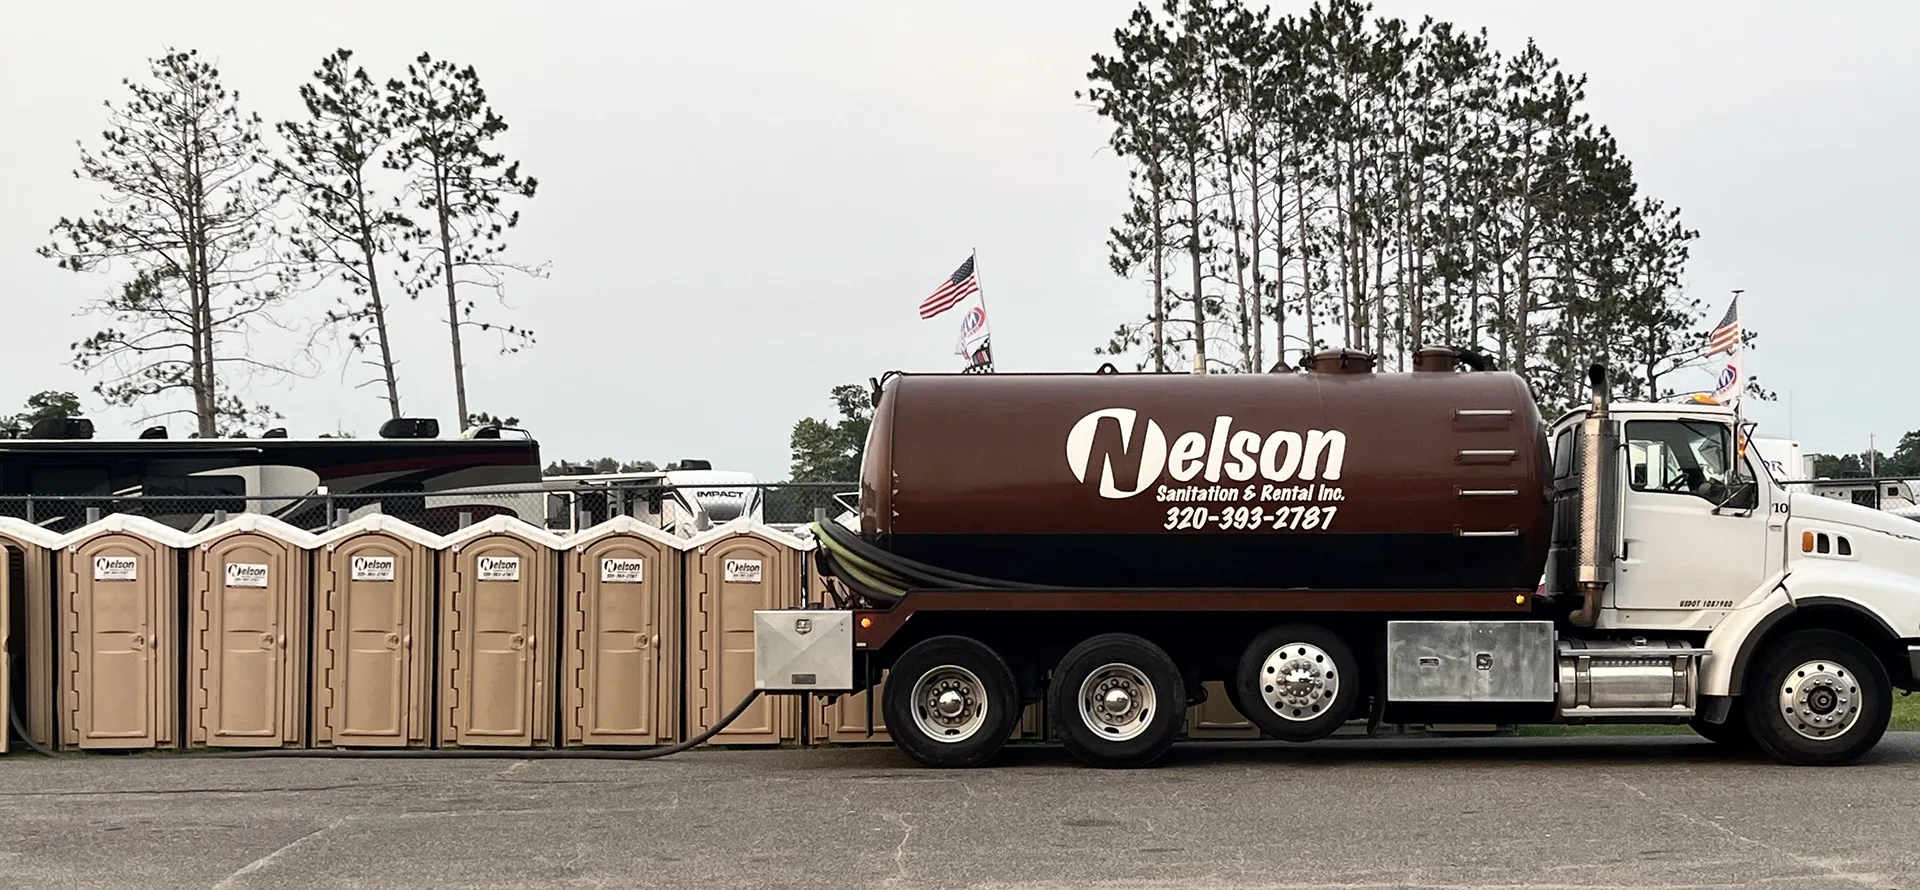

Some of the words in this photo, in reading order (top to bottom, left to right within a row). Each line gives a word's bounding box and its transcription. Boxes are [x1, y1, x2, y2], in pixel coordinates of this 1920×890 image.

[1066, 407, 1346, 499] Nelson
[1157, 484, 1239, 501] Sanitation
[1242, 484, 1256, 501] &
[1260, 484, 1315, 501] Rental
[1317, 483, 1345, 501] Inc.
[1771, 503, 1788, 513] 10
[1163, 506, 1337, 530] 320-393-2787
[96, 557, 135, 570] Nelson
[228, 564, 266, 577] Nelson
[354, 557, 392, 571] Nelson
[480, 557, 517, 571] Nelson
[604, 559, 640, 573] Nelson
[726, 561, 760, 573] Nelson
